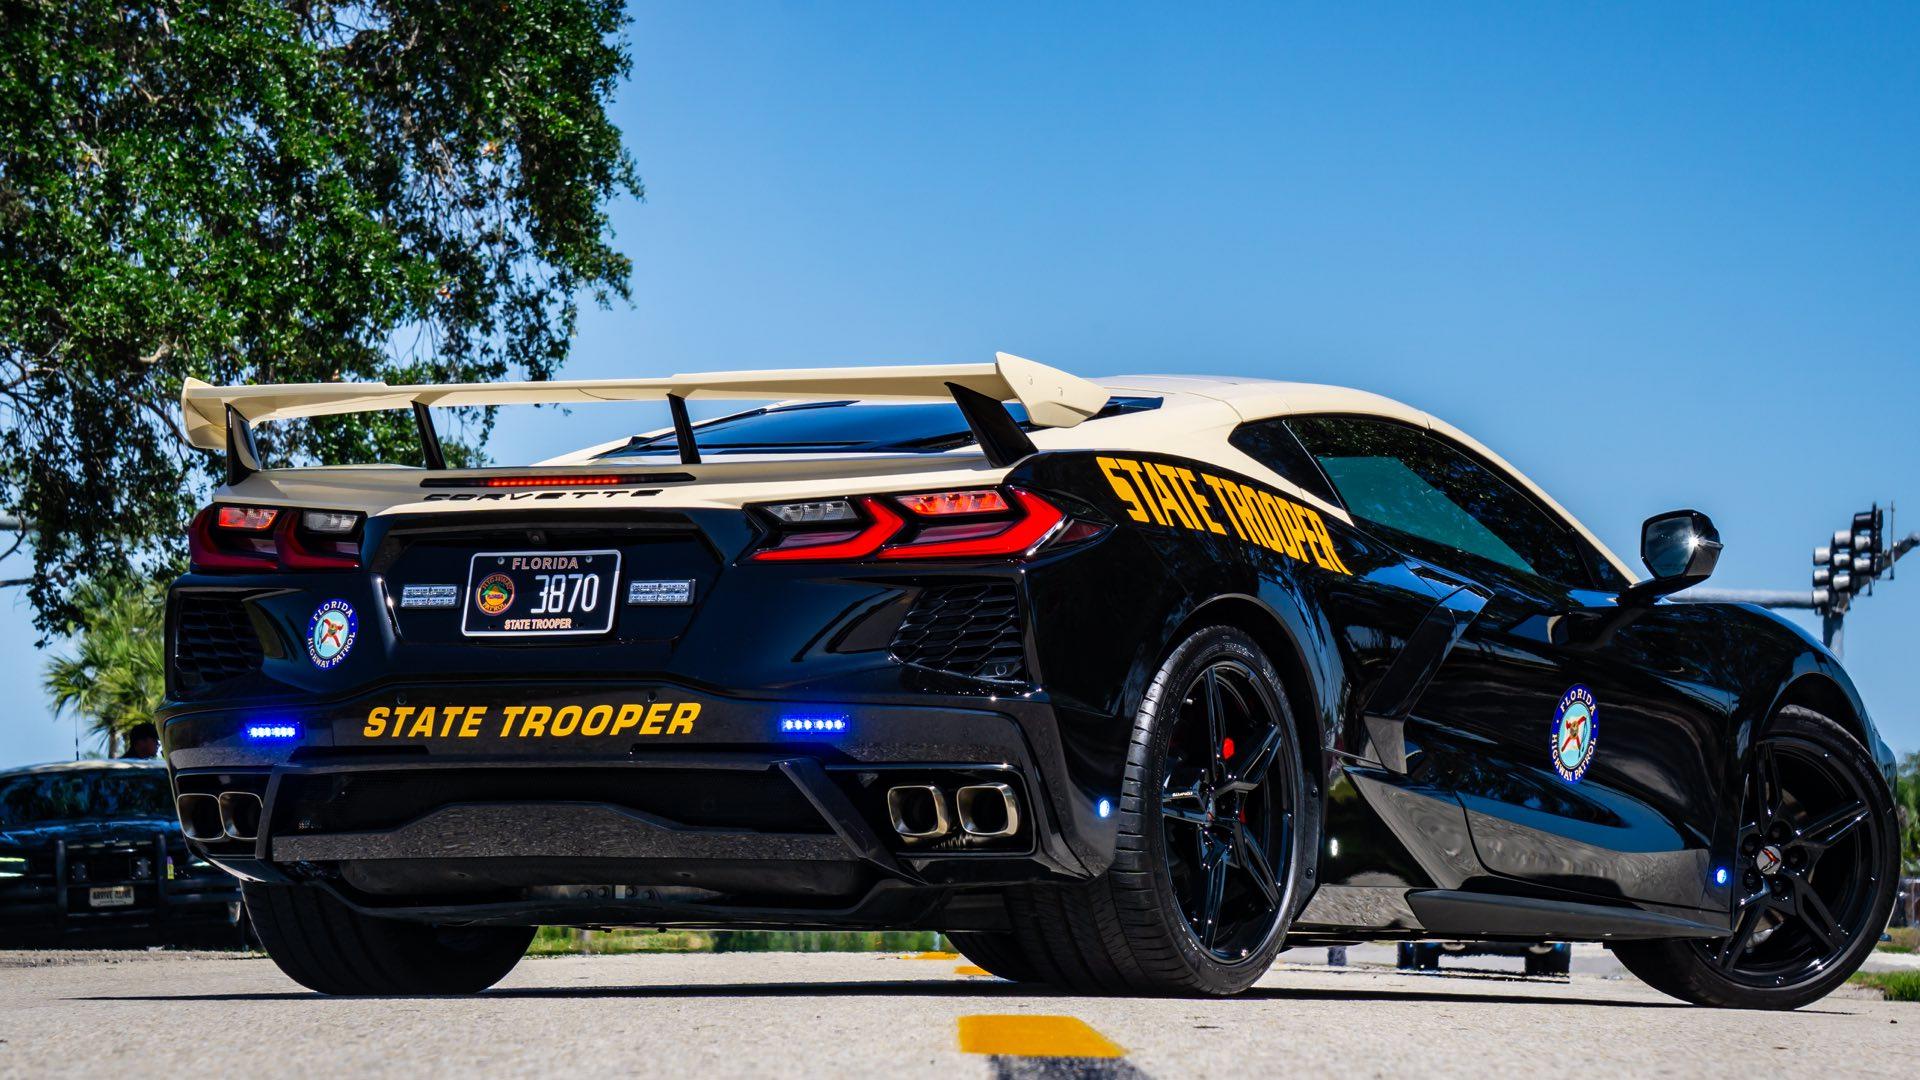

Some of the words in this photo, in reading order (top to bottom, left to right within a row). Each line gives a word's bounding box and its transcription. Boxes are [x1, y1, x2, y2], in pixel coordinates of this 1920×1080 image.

[424, 489, 664, 501] CORVETTE
[1096, 456, 1227, 536] STATE
[1201, 473, 1353, 576] TROOPER
[512, 557, 579, 570] FLORIDA
[530, 573, 600, 614] 3870
[313, 600, 353, 622] FLORIDA
[504, 619, 531, 630] STATE
[531, 618, 572, 630] TROOPER
[307, 637, 330, 668] HIGHWAY
[332, 632, 356, 666] PATROL
[1560, 688, 1596, 716] FLORIDA
[363, 706, 488, 738] STATE
[500, 702, 702, 737] TROOPER
[1551, 733, 1573, 782] HIGHWAY
[1574, 738, 1597, 780] PATROL
